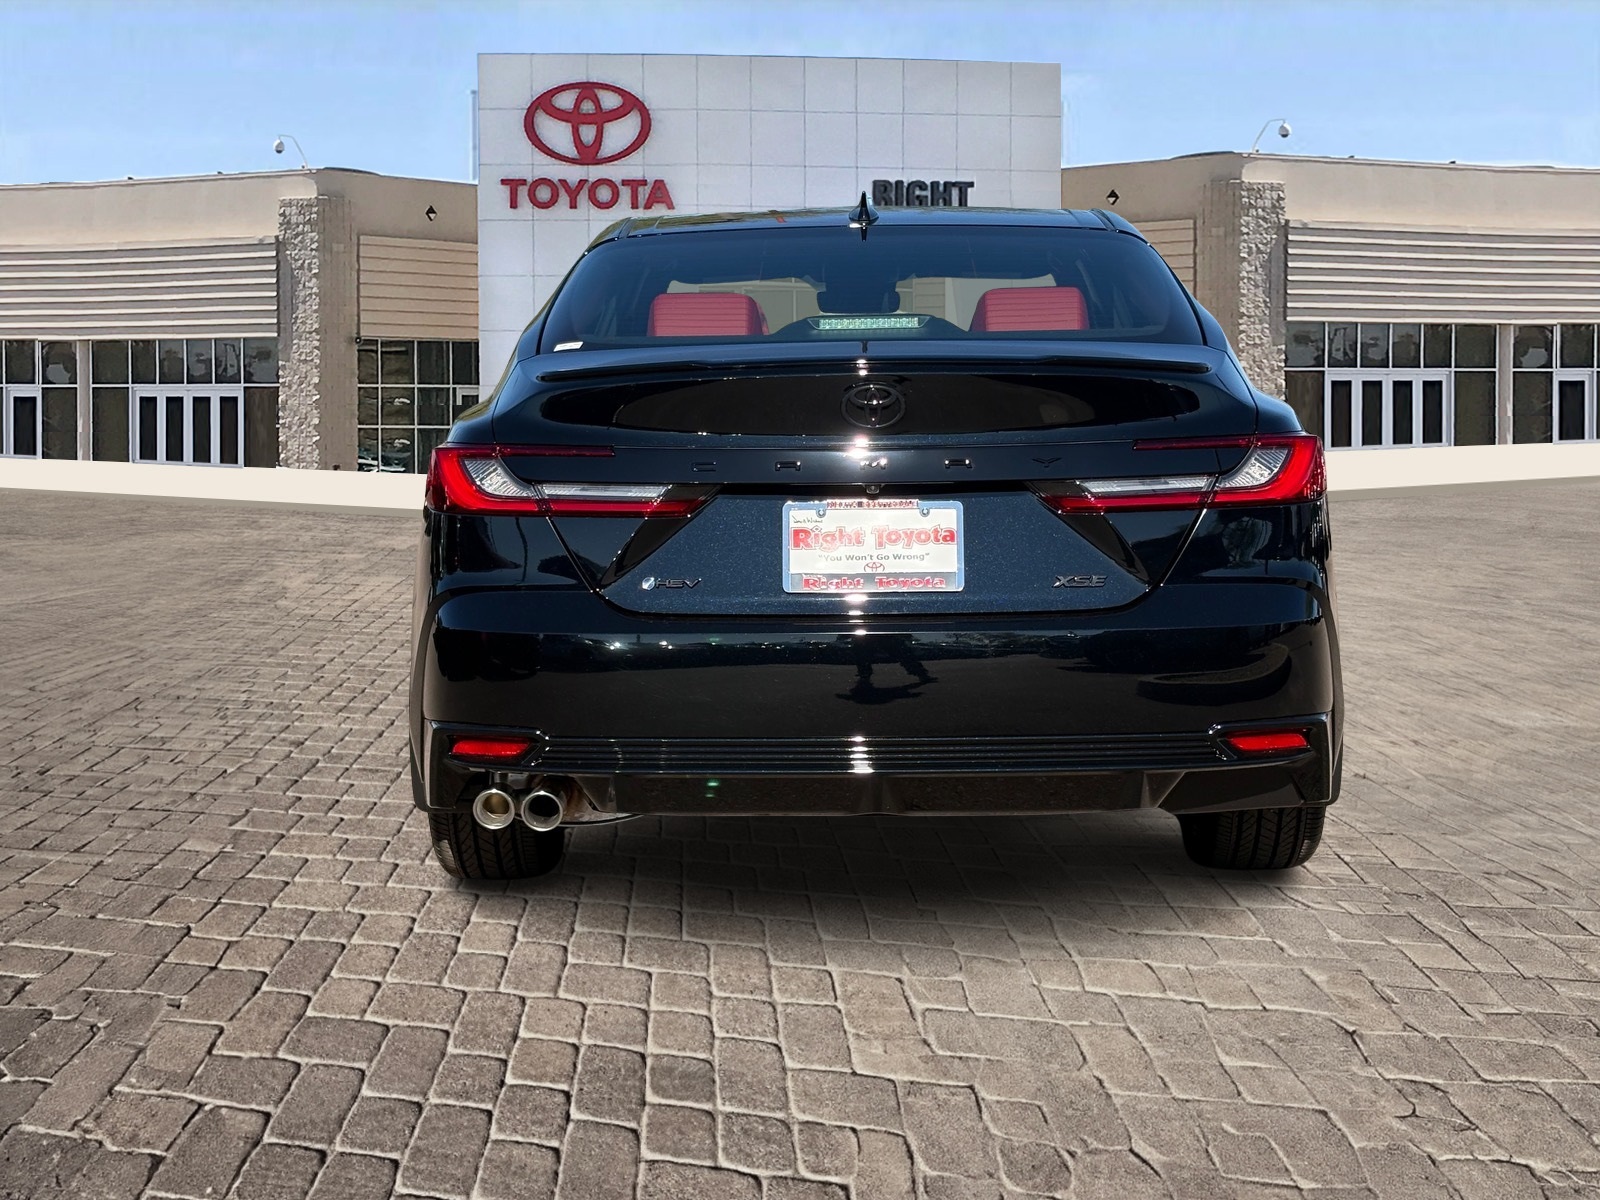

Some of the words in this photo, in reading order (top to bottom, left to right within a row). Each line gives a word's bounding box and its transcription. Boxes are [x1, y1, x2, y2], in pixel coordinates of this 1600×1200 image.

[500, 177, 675, 210] TOYOTA
[872, 180, 975, 206] RIGHT
[690, 457, 1063, 473] CAMRY
[791, 525, 866, 552] Right
[871, 524, 958, 549] Toyota
[876, 553, 890, 561] Go
[656, 577, 702, 589] HEV
[802, 576, 864, 591] Right
[875, 576, 946, 590] Toyota
[1051, 574, 1109, 588] XSE
